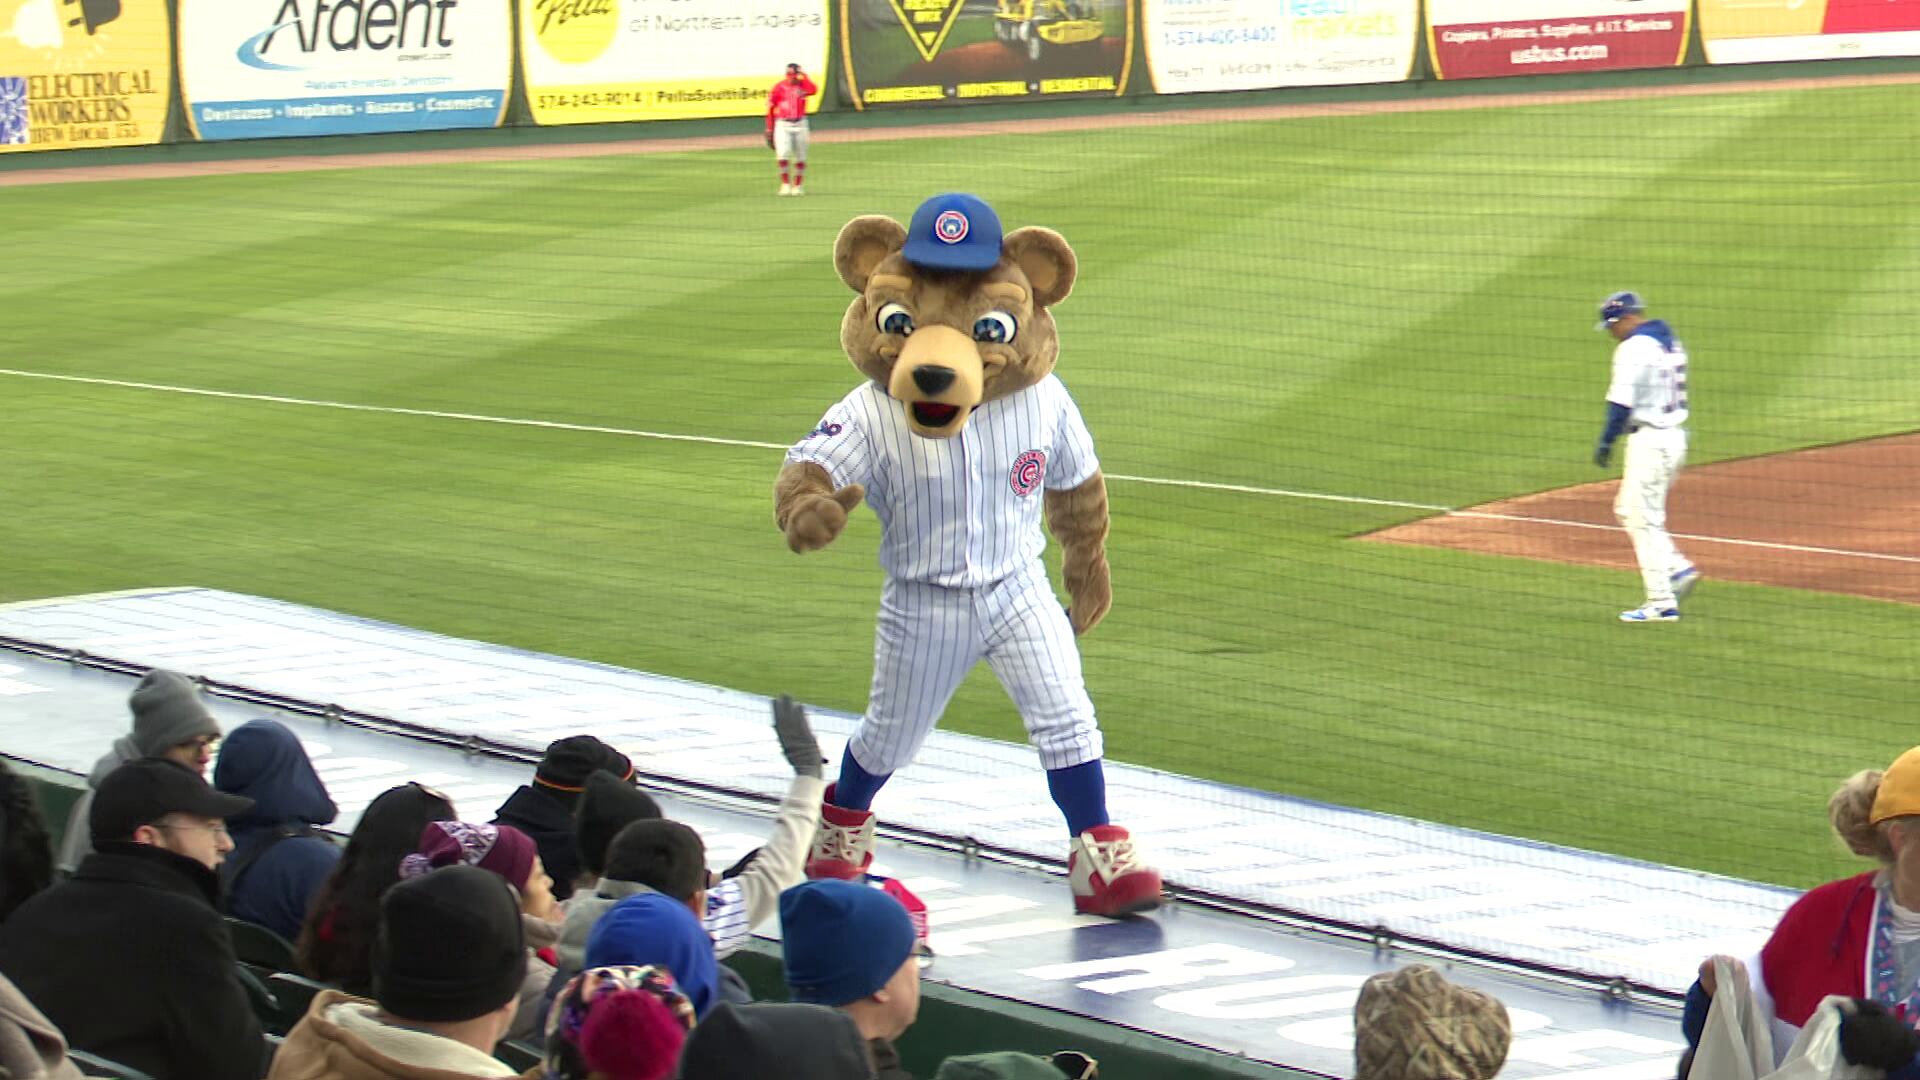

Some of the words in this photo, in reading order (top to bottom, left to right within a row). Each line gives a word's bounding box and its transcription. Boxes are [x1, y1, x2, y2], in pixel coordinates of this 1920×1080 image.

[29, 69, 158, 100] ELECTRICAL
[656, 88, 770, 104] PellaSouthBen
[29, 97, 132, 125] WORKERS
